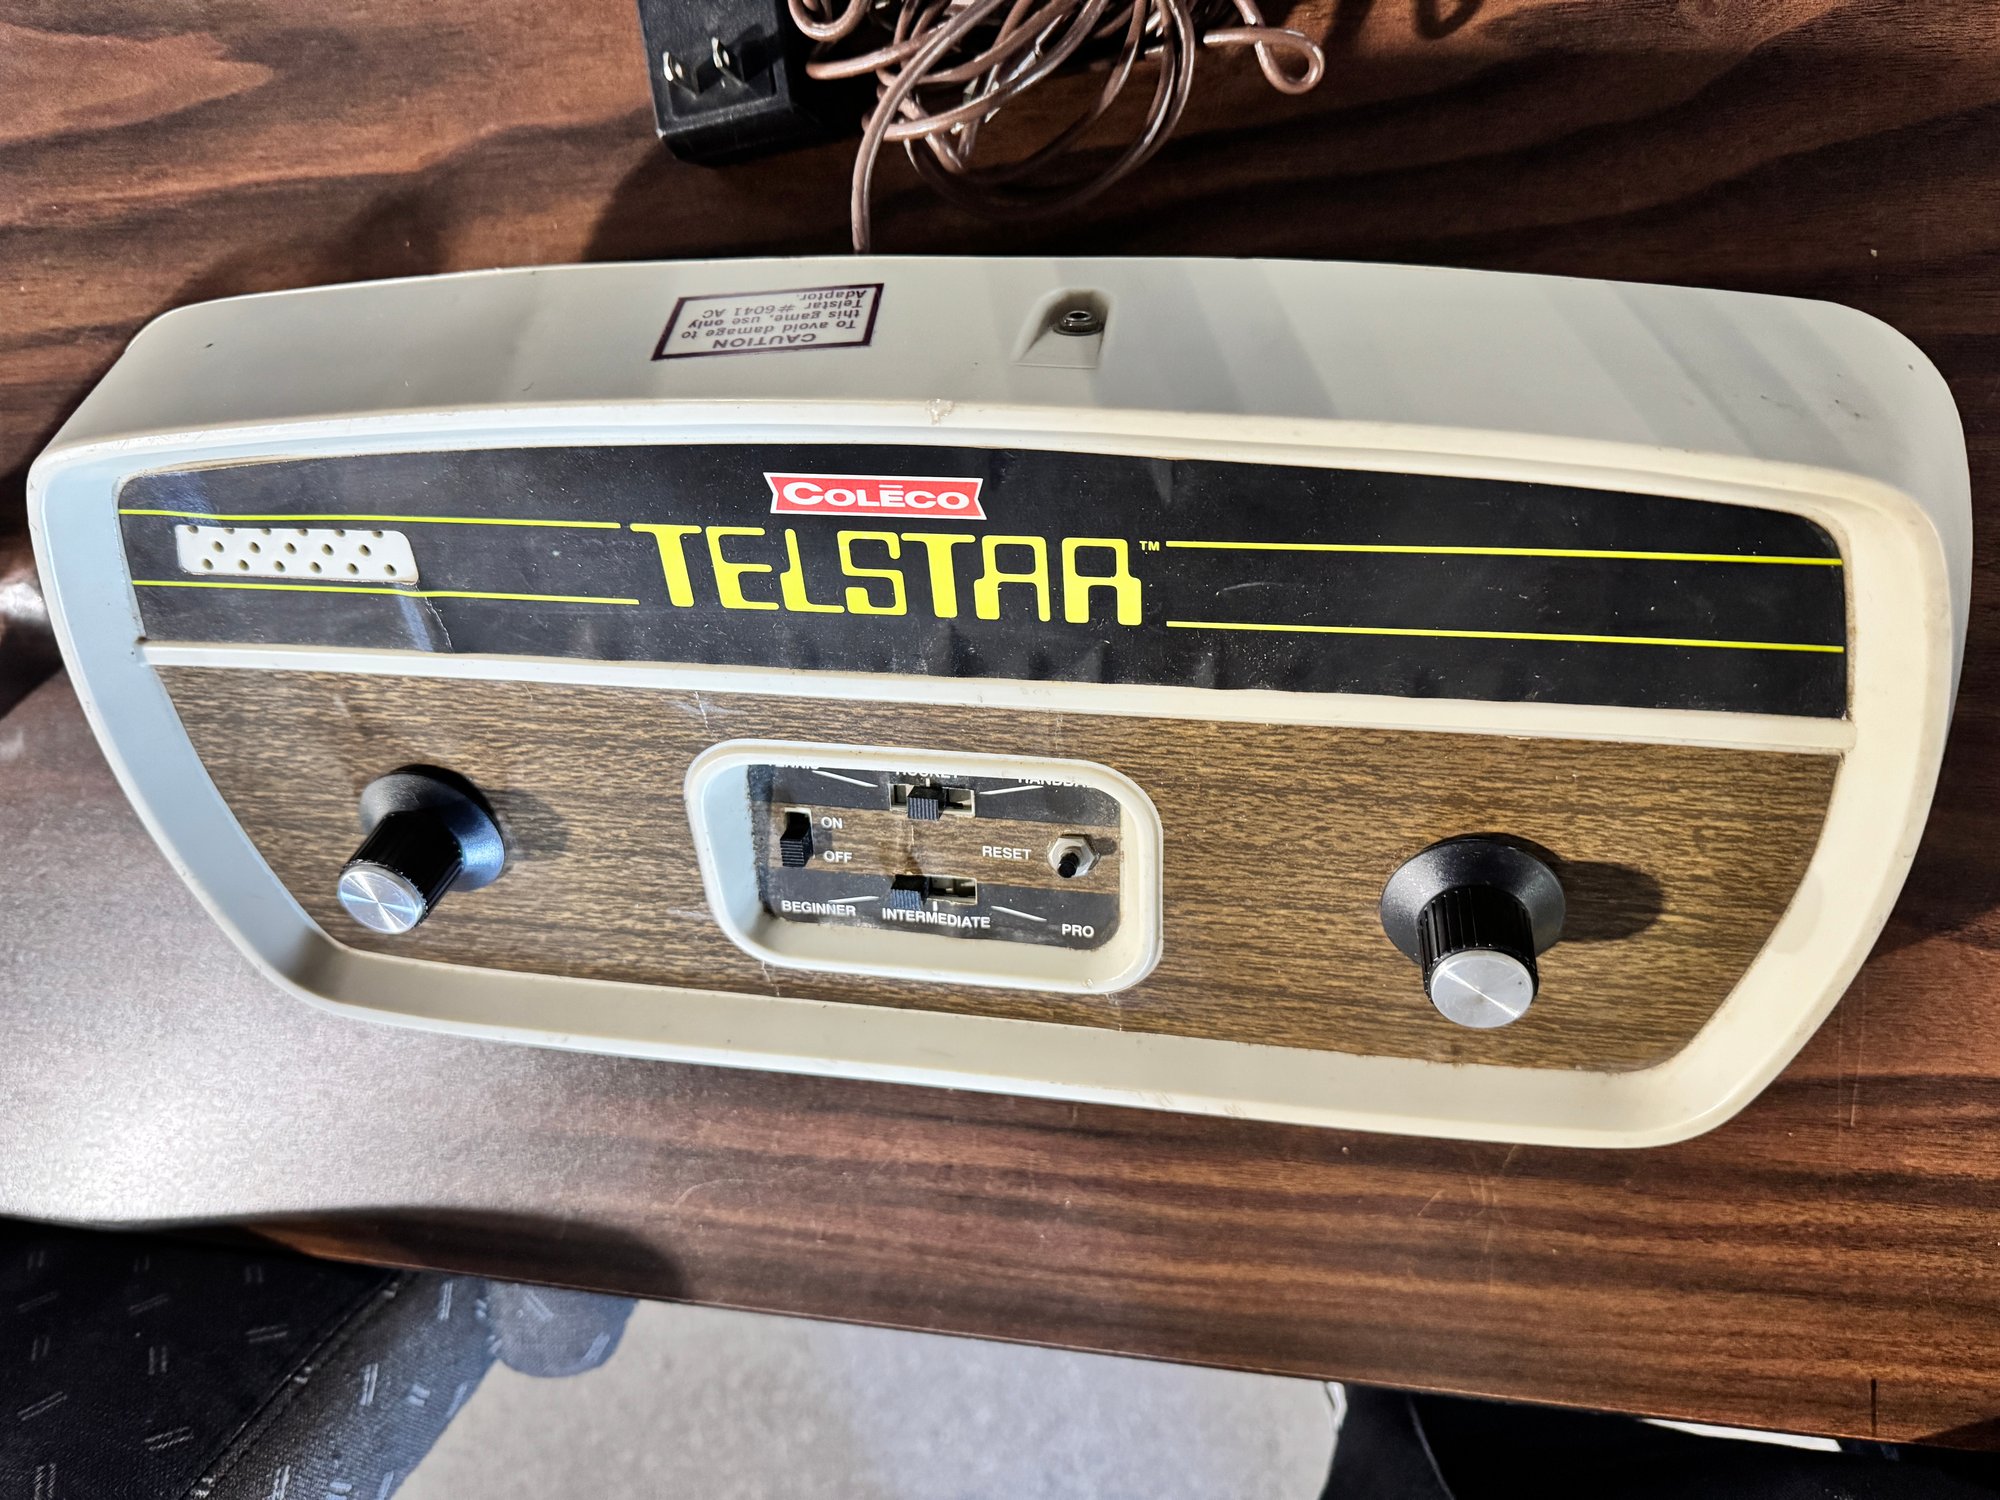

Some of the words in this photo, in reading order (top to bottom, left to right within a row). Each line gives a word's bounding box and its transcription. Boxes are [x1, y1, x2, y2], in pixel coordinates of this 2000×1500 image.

[796, 290, 867, 301] Adaptor.
[734, 304, 796, 316] #6041
[804, 299, 862, 309] Telstar
[702, 309, 726, 318] AC
[828, 309, 860, 319] this
[688, 319, 724, 329] only
[732, 316, 761, 325] use
[836, 320, 856, 329] To
[706, 325, 774, 337] damage
[782, 322, 828, 333] avoid
[681, 331, 697, 339] to
[712, 333, 816, 349] CAUTION
[629, 523, 1143, 627] TELSTAR
[821, 816, 843, 829] ON
[823, 850, 853, 863] OFF
[982, 845, 1031, 860] RESET
[781, 900, 856, 917] BEGINNER
[881, 908, 991, 929] INTERMEDIATE
[1061, 923, 1095, 938] PRO
